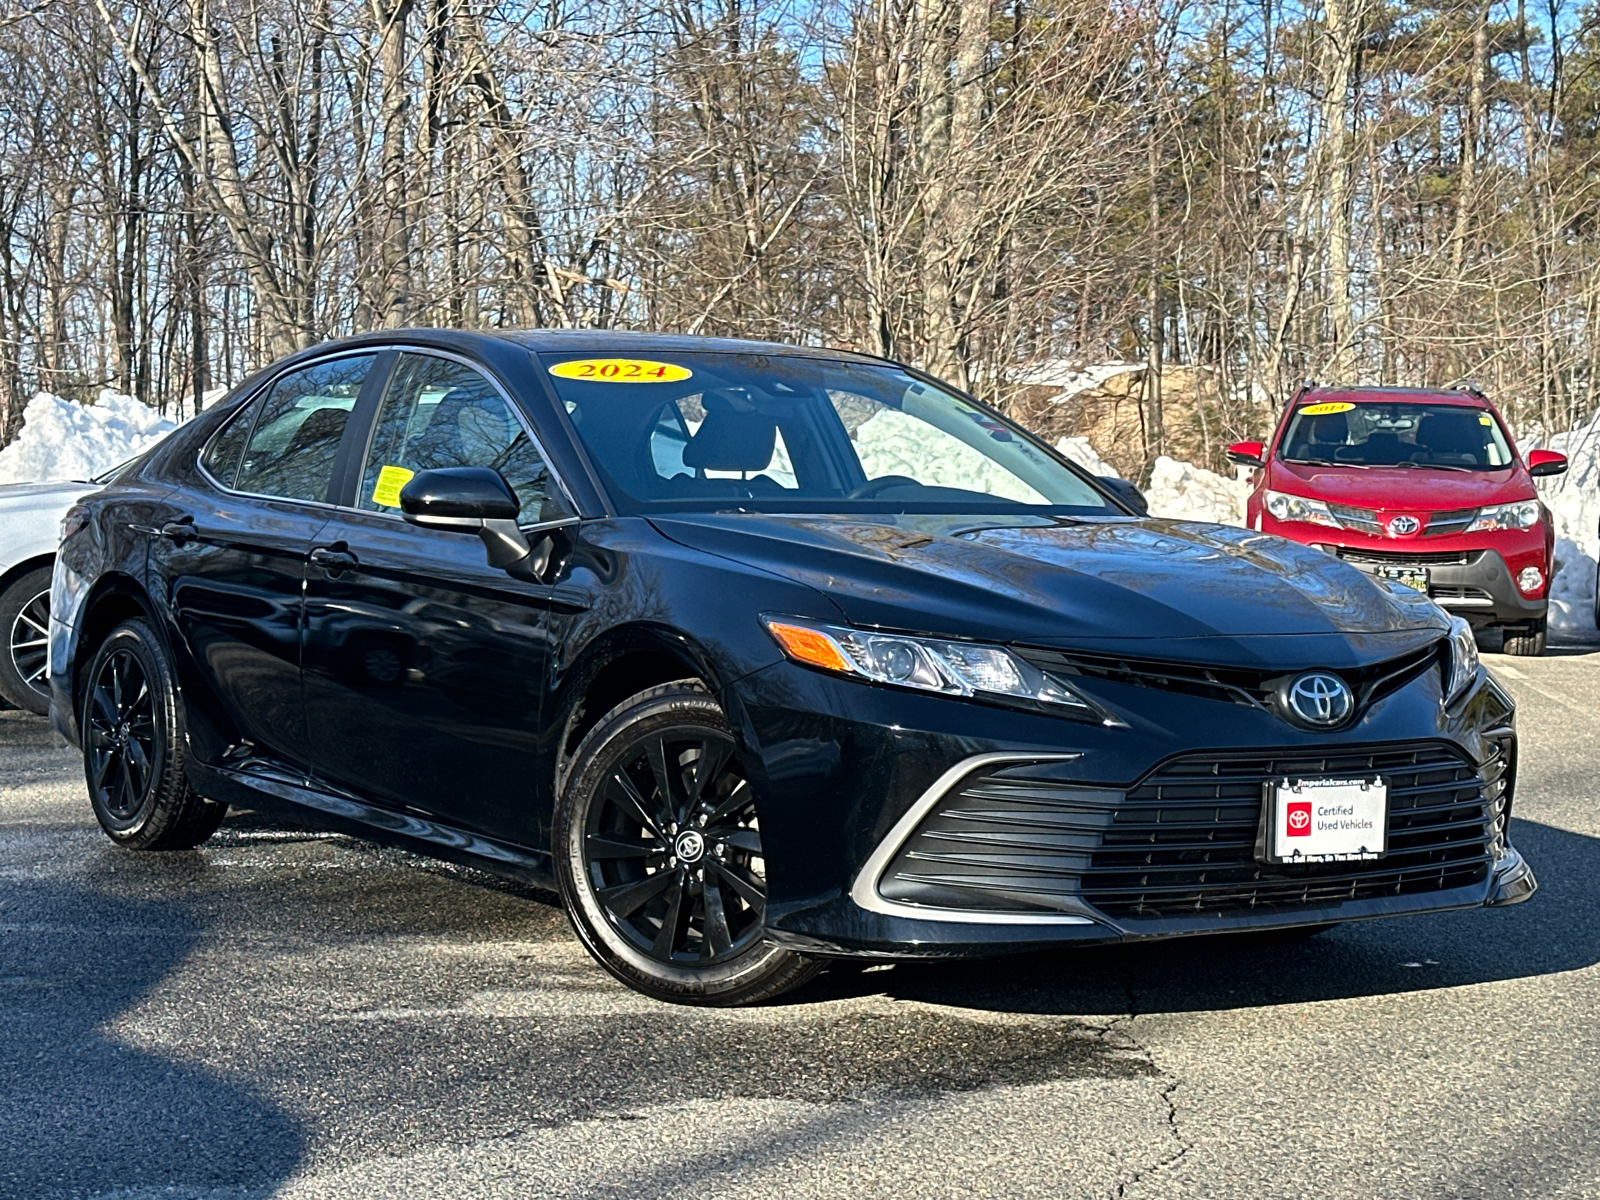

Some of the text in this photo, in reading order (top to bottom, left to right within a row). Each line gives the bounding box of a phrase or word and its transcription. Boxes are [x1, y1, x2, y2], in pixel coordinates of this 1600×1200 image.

[577, 364, 667, 378] 2024
[1309, 404, 1345, 414] 2014
[1317, 805, 1354, 816] Certified
[1317, 819, 1373, 831] Used Vehicles
[1282, 855, 1293, 863] We
[1294, 855, 1306, 863] Sell
[1325, 854, 1334, 862] So
[1335, 853, 1347, 861] You
[1347, 853, 1362, 861] Save
